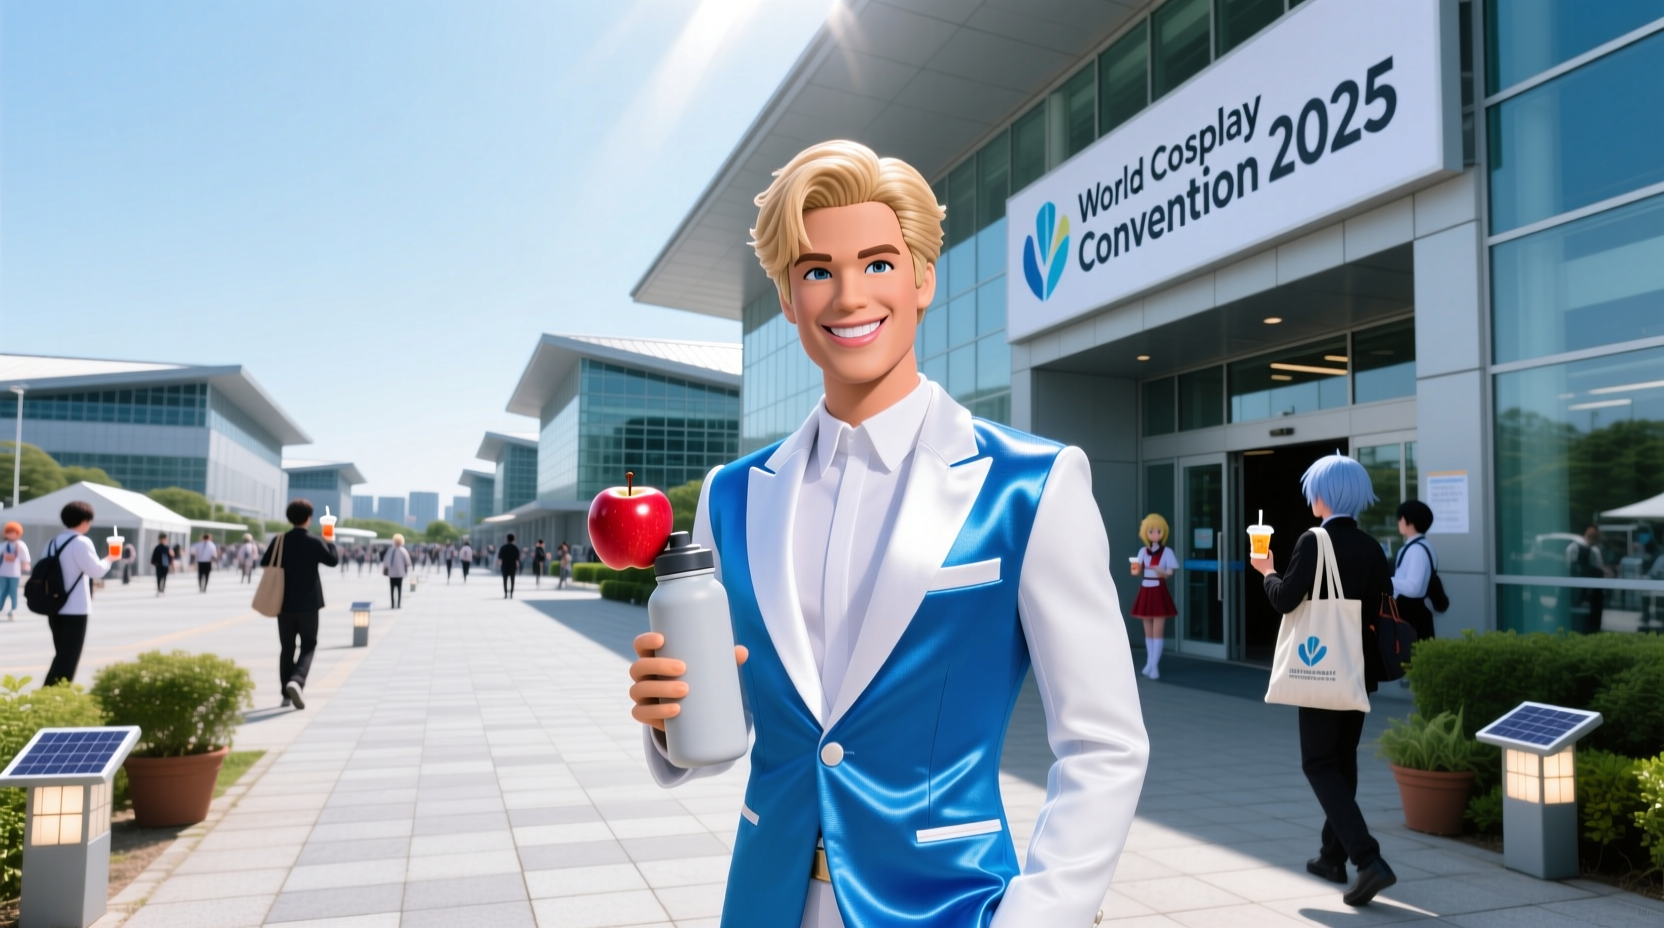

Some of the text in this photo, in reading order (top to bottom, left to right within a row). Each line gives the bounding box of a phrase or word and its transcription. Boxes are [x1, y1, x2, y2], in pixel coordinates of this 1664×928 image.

[1078, 94, 1262, 224] World Cosplay
[1078, 55, 1397, 272] Convention 2025
